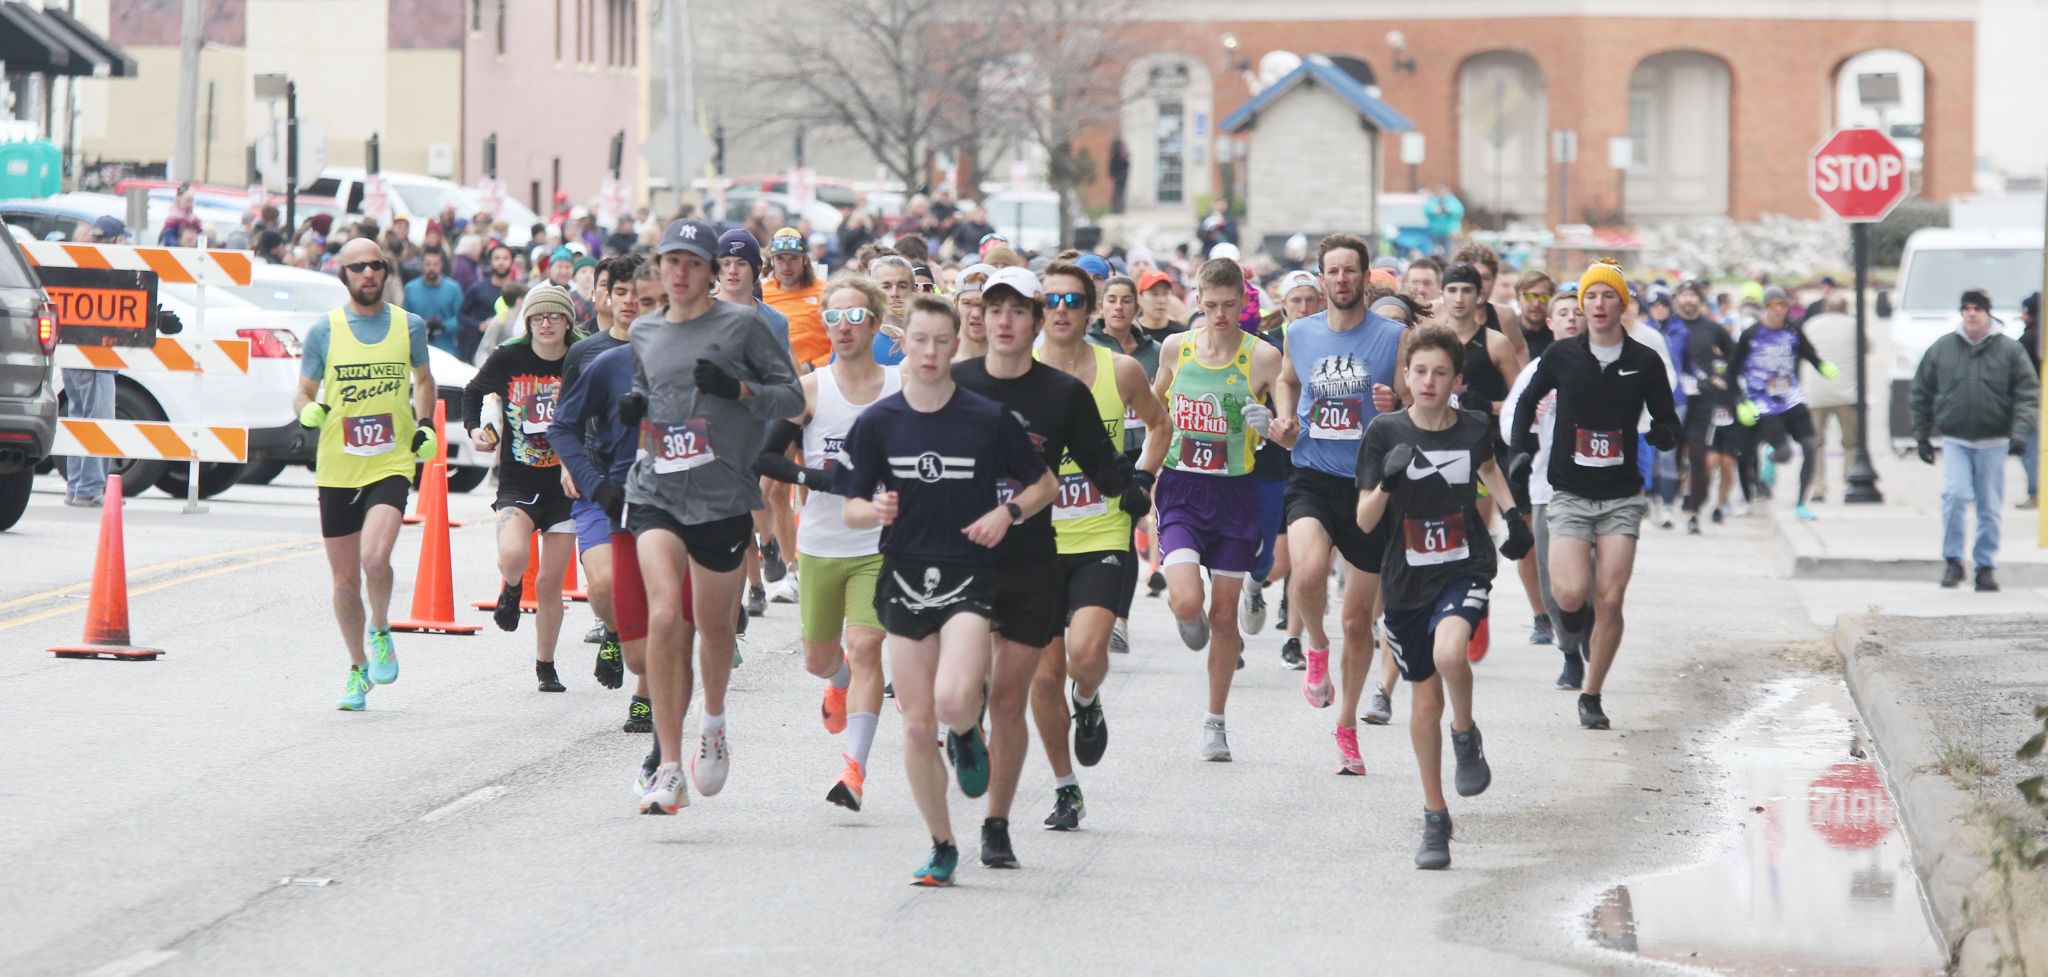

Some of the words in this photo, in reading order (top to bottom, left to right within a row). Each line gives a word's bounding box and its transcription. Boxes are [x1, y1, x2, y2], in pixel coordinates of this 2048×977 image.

[1818, 154, 1902, 192] STOP
[680, 224, 698, 240] NY
[47, 291, 138, 322] TOUR
[340, 366, 370, 379] RUN
[372, 364, 401, 377] WELL
[341, 380, 401, 407] Racing
[1175, 394, 1213, 417] Metro
[1320, 407, 1350, 428] 204
[354, 424, 385, 445] 192
[664, 432, 699, 458] 382
[827, 440, 846, 451] RU
[1192, 448, 1213, 467] 49
[1590, 438, 1609, 456] 98
[1059, 481, 1091, 506] 191
[1424, 527, 1446, 551] 61
